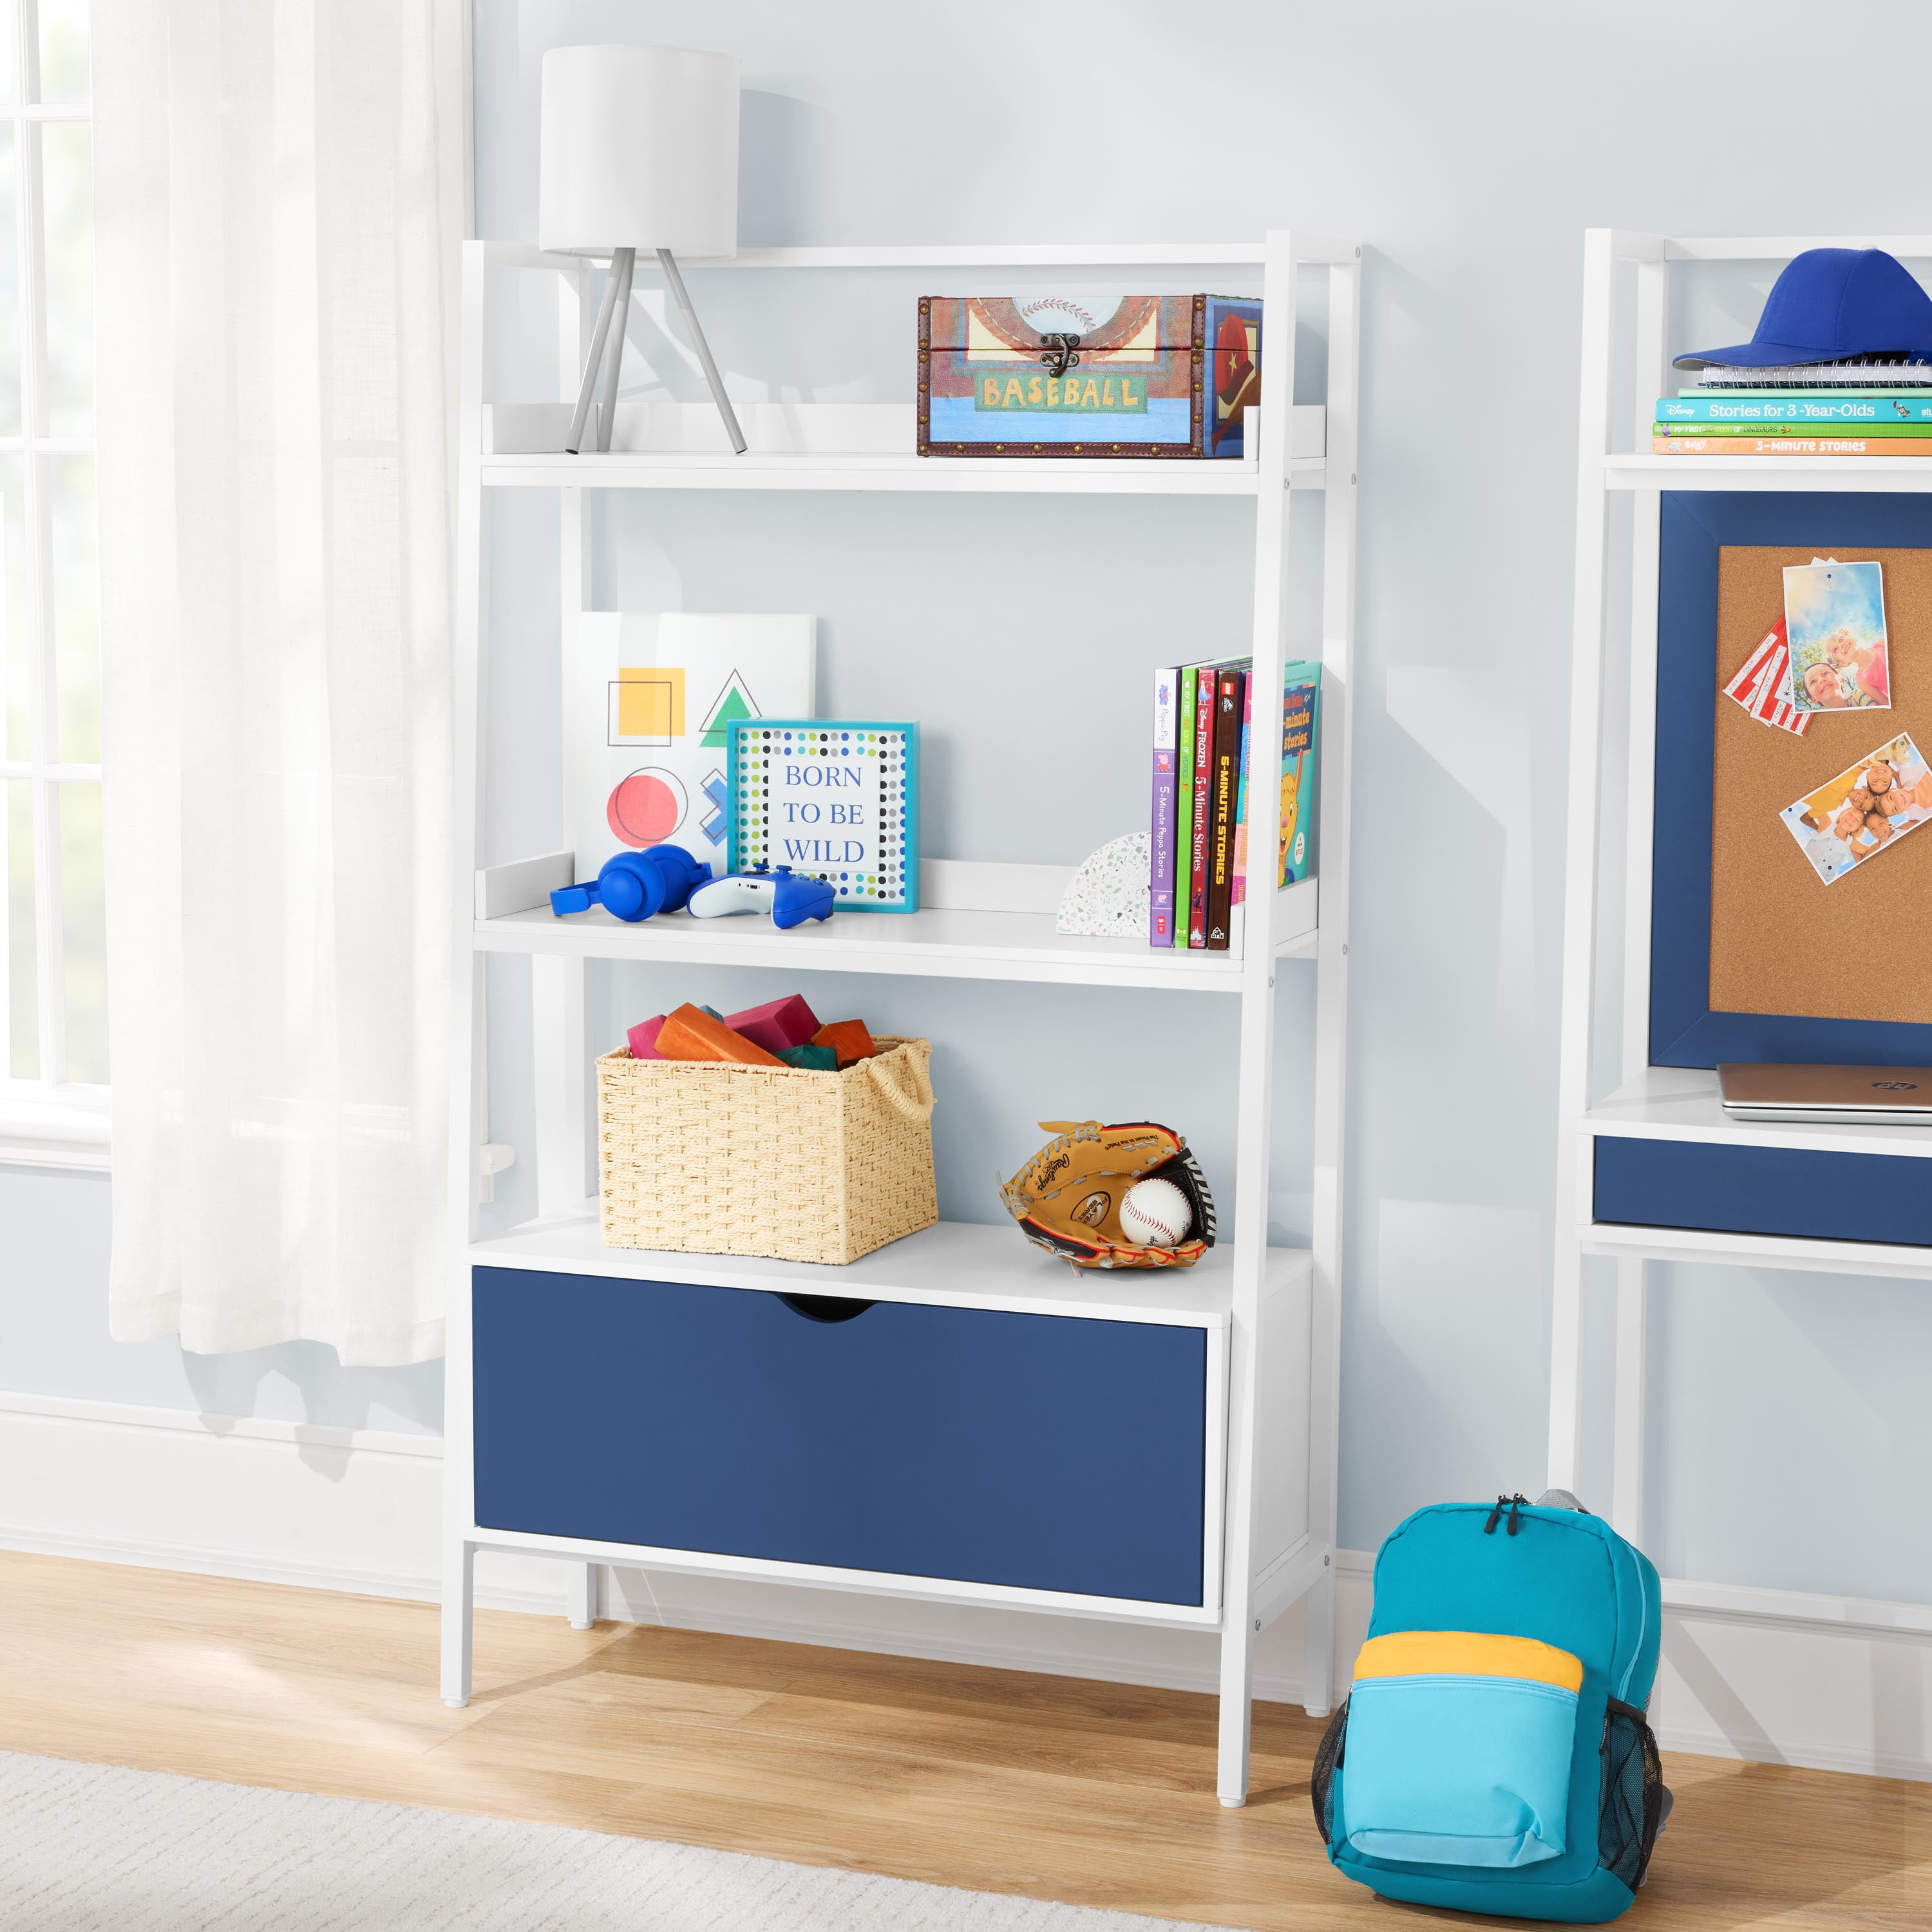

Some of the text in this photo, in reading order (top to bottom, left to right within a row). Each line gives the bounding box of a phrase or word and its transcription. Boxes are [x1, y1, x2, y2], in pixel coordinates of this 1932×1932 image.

[983, 377, 1138, 406] BASEBALL
[1665, 404, 1695, 417] Disney
[1709, 404, 1761, 417] Stories
[1763, 404, 1785, 417] for
[1159, 708, 1169, 741] Peppa Pig
[1283, 730, 1308, 750] stories
[784, 765, 863, 787] BORN
[1193, 709, 1208, 871] Disney FROZEN 5-Minute Stories
[783, 802, 864, 824] TO BE
[1216, 755, 1229, 885] 5-MINUTE STORIES
[1157, 786, 1170, 878] 5-Minute Peppa Stories
[783, 839, 864, 862] WILD
[1037, 1153, 1070, 1191] Rawlings
[1077, 1199, 1098, 1220] SERIES
